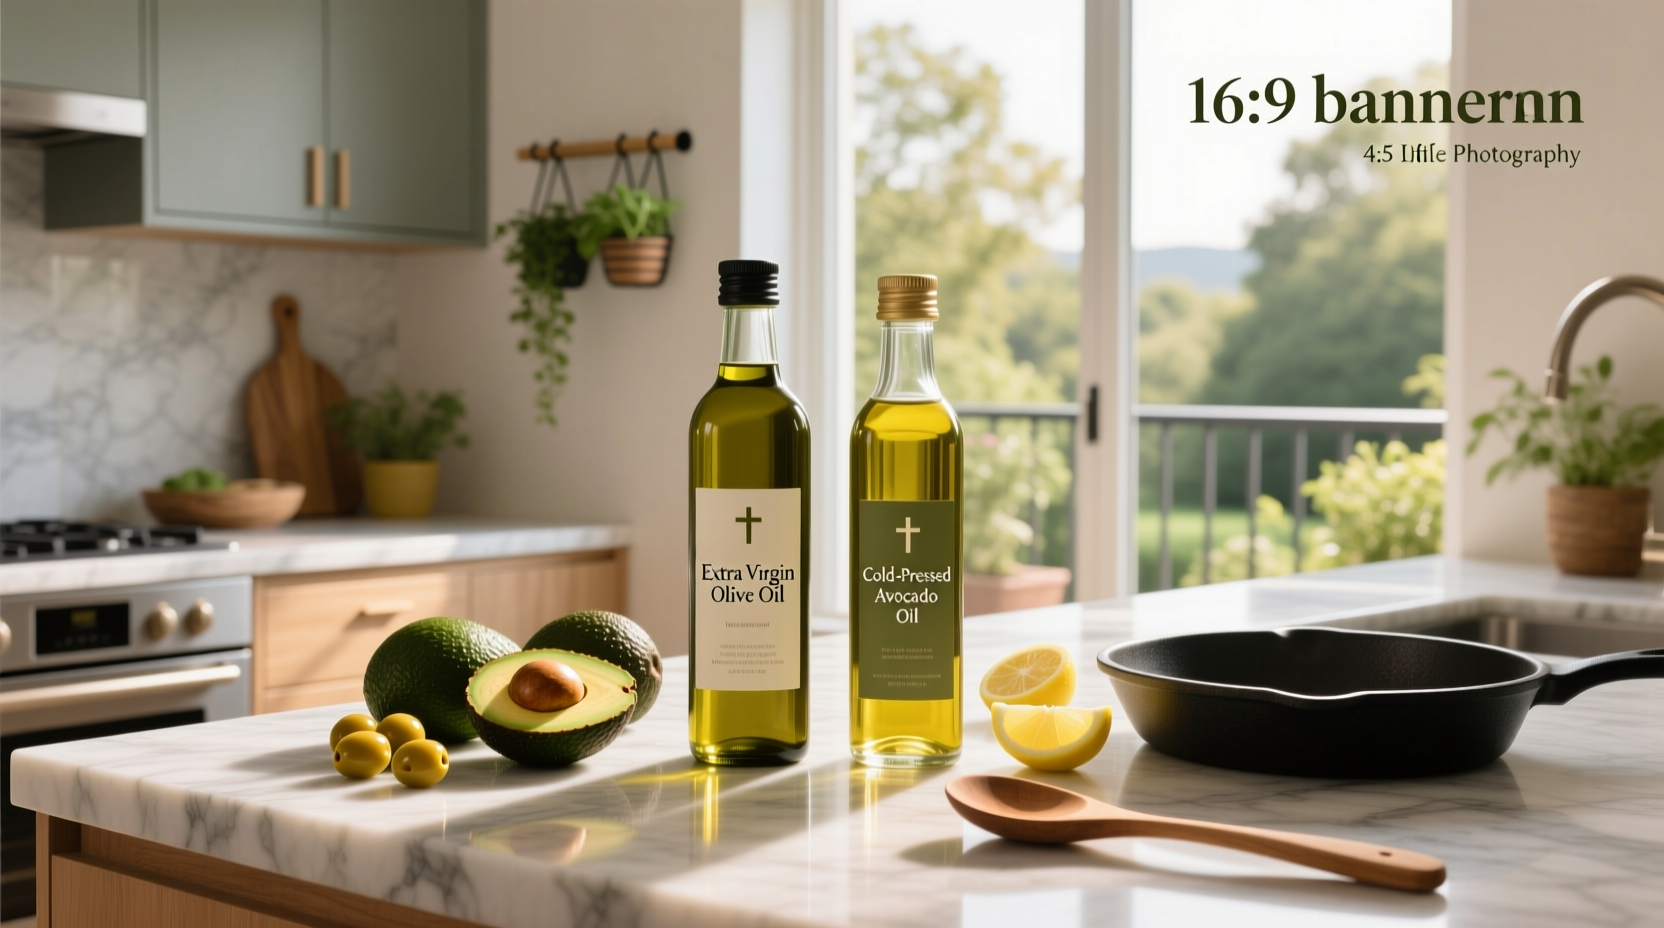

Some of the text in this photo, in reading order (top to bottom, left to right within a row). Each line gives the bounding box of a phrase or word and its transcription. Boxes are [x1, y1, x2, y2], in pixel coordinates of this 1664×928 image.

[701, 563, 795, 586] Extra Virgin
[862, 565, 952, 583] Cold-Pressed
[711, 584, 785, 603] Olive Oil
[874, 587, 939, 604] Avocado
[896, 607, 919, 624] Oil
